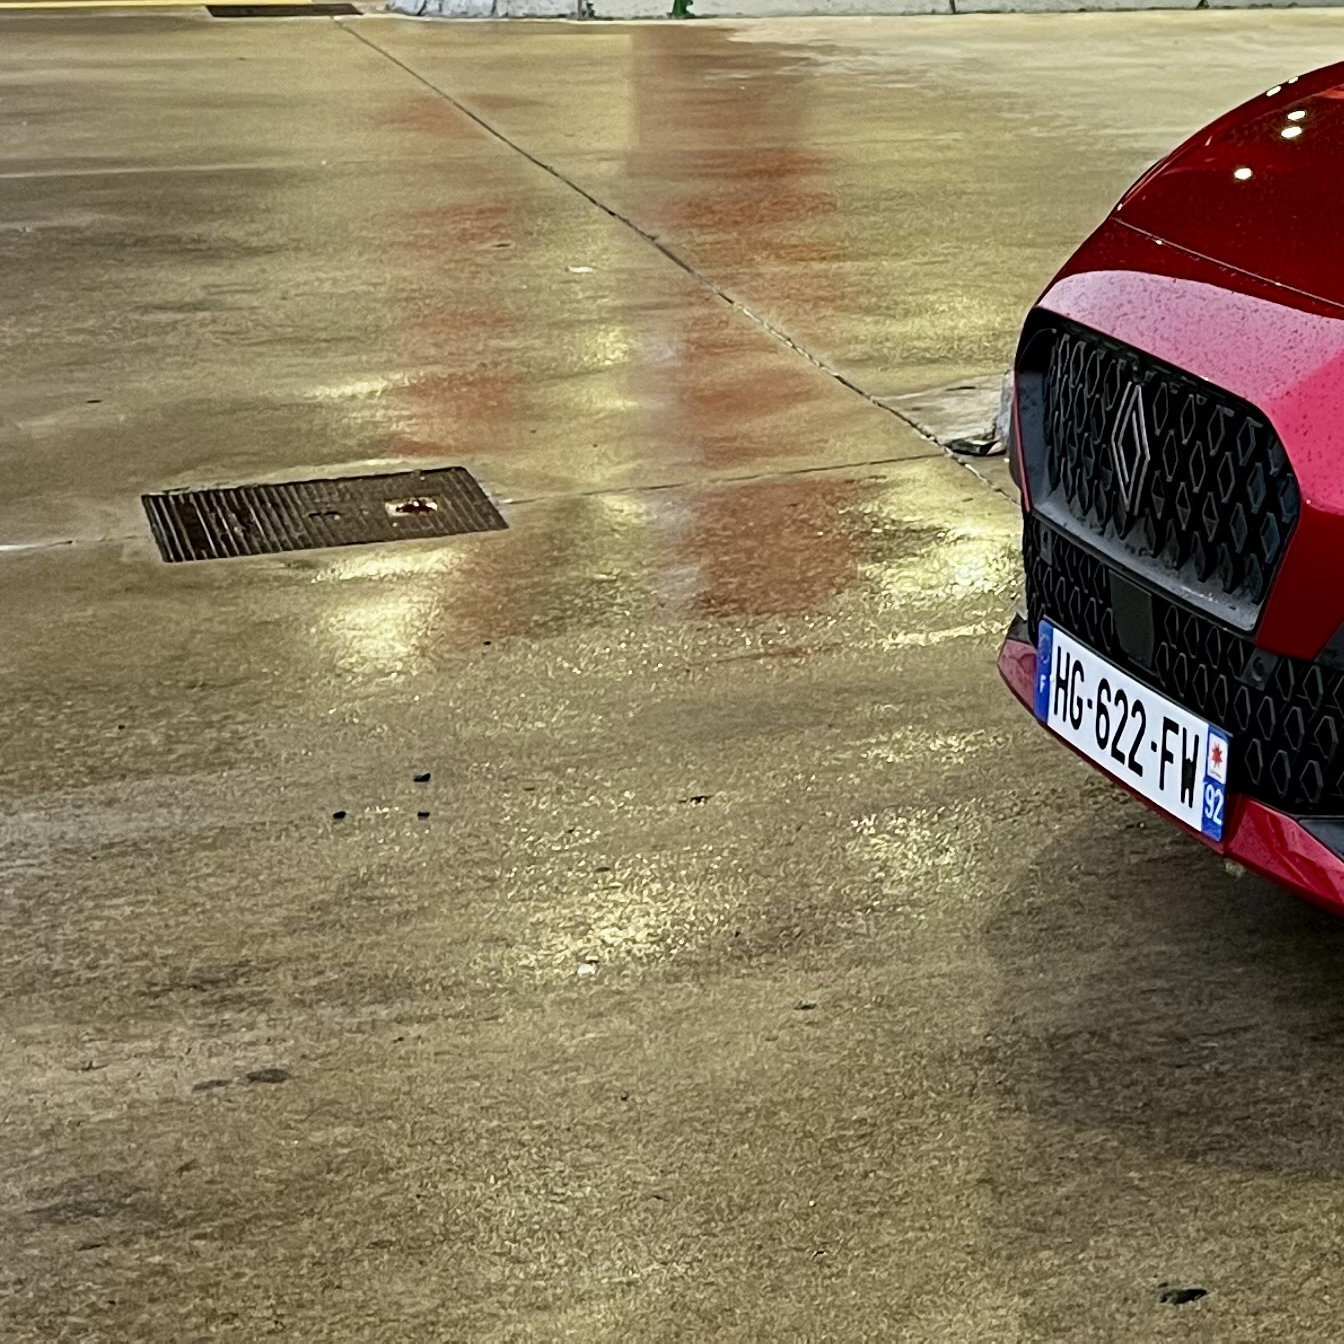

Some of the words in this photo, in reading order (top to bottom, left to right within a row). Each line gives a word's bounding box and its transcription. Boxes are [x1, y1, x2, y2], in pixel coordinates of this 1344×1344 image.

[1039, 674, 1047, 694] F
[1053, 645, 1200, 809] HG-622-FW
[1204, 784, 1223, 826] 92
